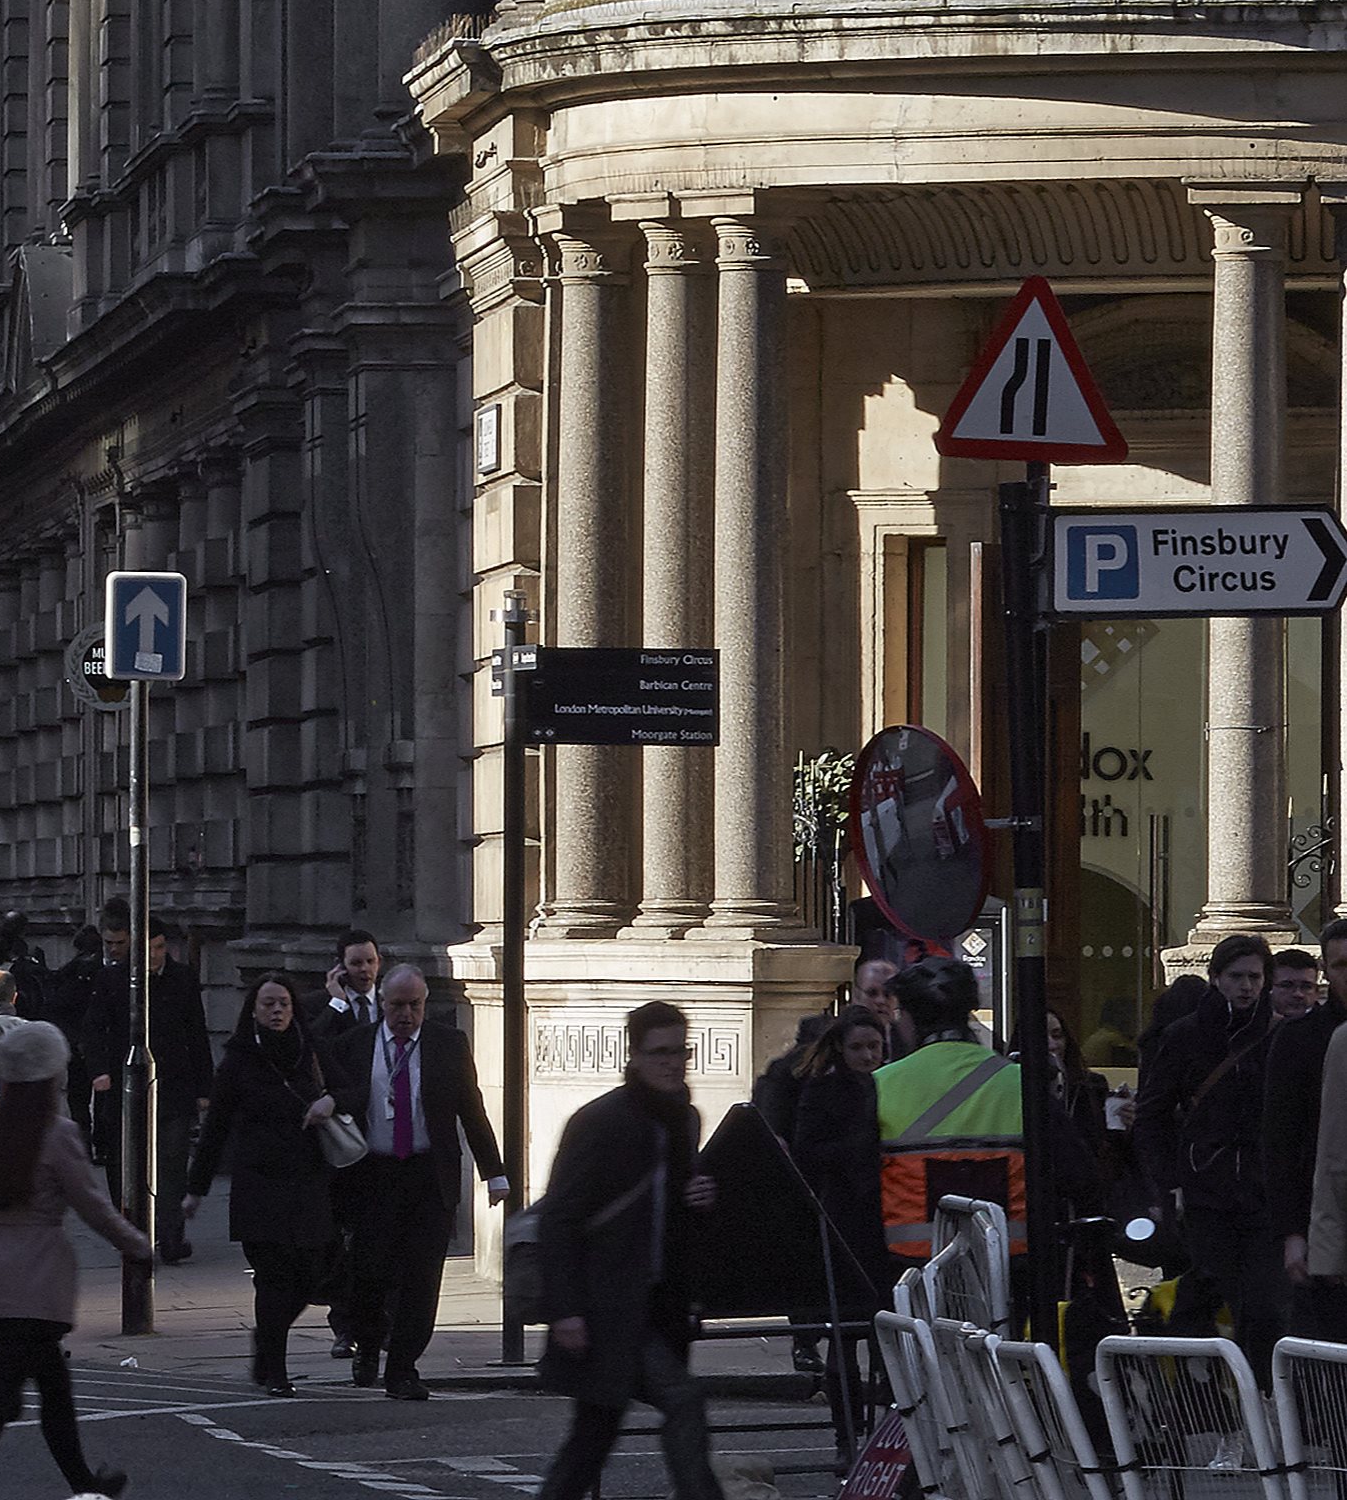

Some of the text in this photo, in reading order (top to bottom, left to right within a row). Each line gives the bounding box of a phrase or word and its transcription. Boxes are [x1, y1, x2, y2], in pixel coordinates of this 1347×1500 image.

[1085, 528, 1289, 593] P Finsbury
[1173, 565, 1276, 592] Circus
[640, 654, 713, 666] Finsbury Circus
[639, 679, 713, 690] Barbican Centre
[554, 703, 586, 714] London
[587, 703, 641, 716] Metropolitan
[642, 703, 682, 717] University
[631, 729, 713, 741] Moorgate Station
[851, 1460, 906, 1497] RIGHT
